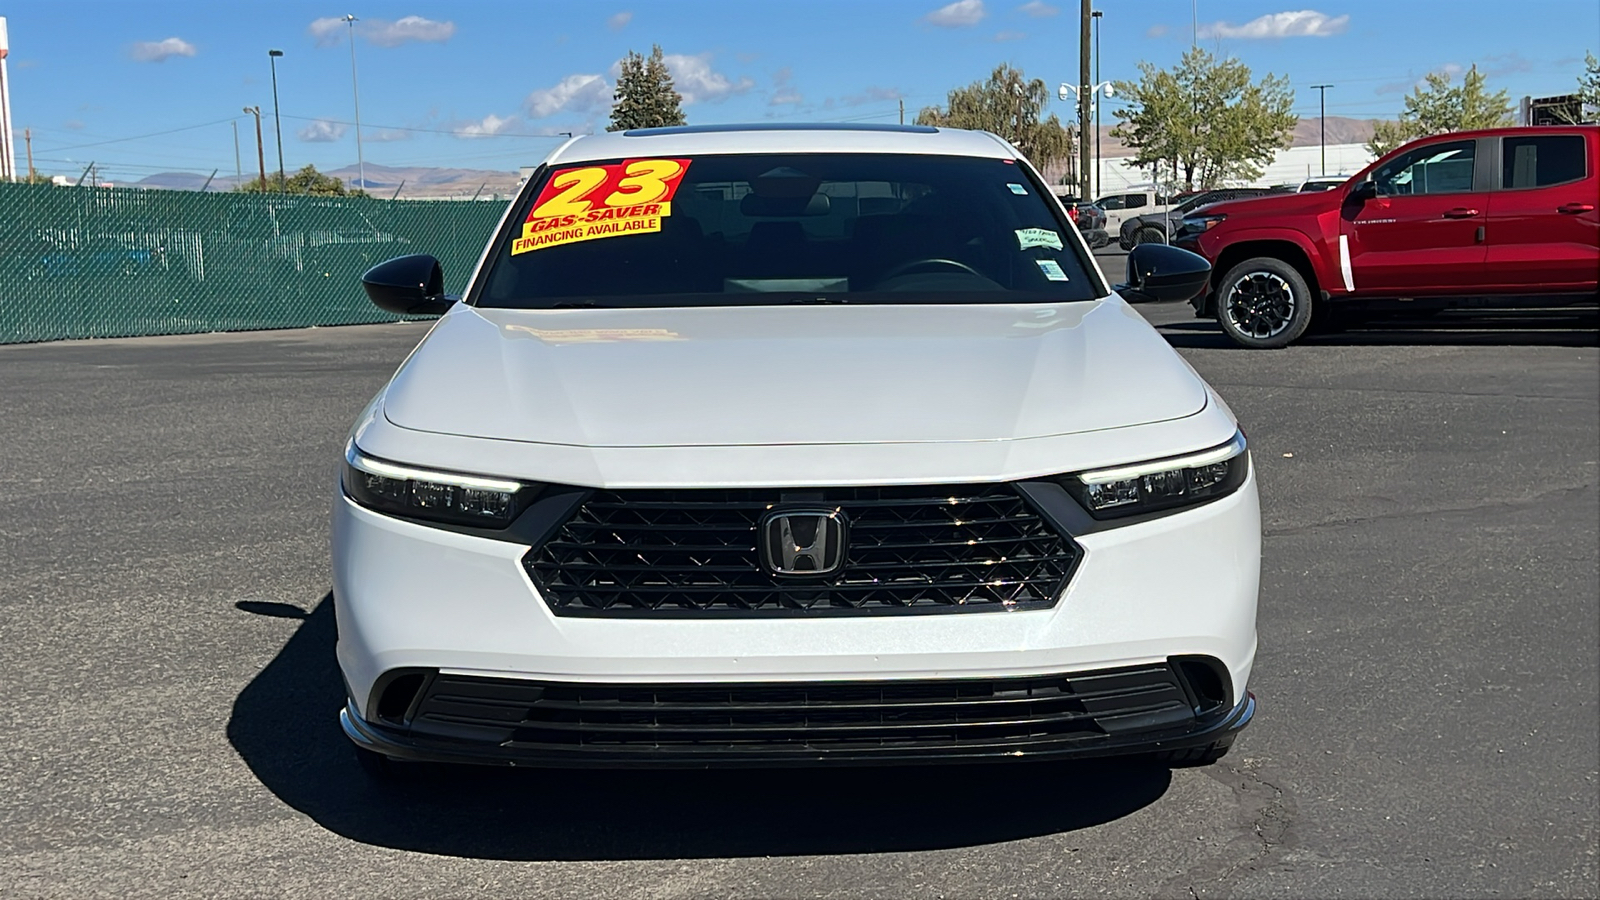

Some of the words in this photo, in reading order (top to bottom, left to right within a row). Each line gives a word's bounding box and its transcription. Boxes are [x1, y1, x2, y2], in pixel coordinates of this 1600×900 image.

[533, 159, 684, 219] 23
[515, 228, 584, 251] FINANCING
[586, 219, 657, 236] AVAILABLE
[530, 204, 662, 234] GAS-SAVER
